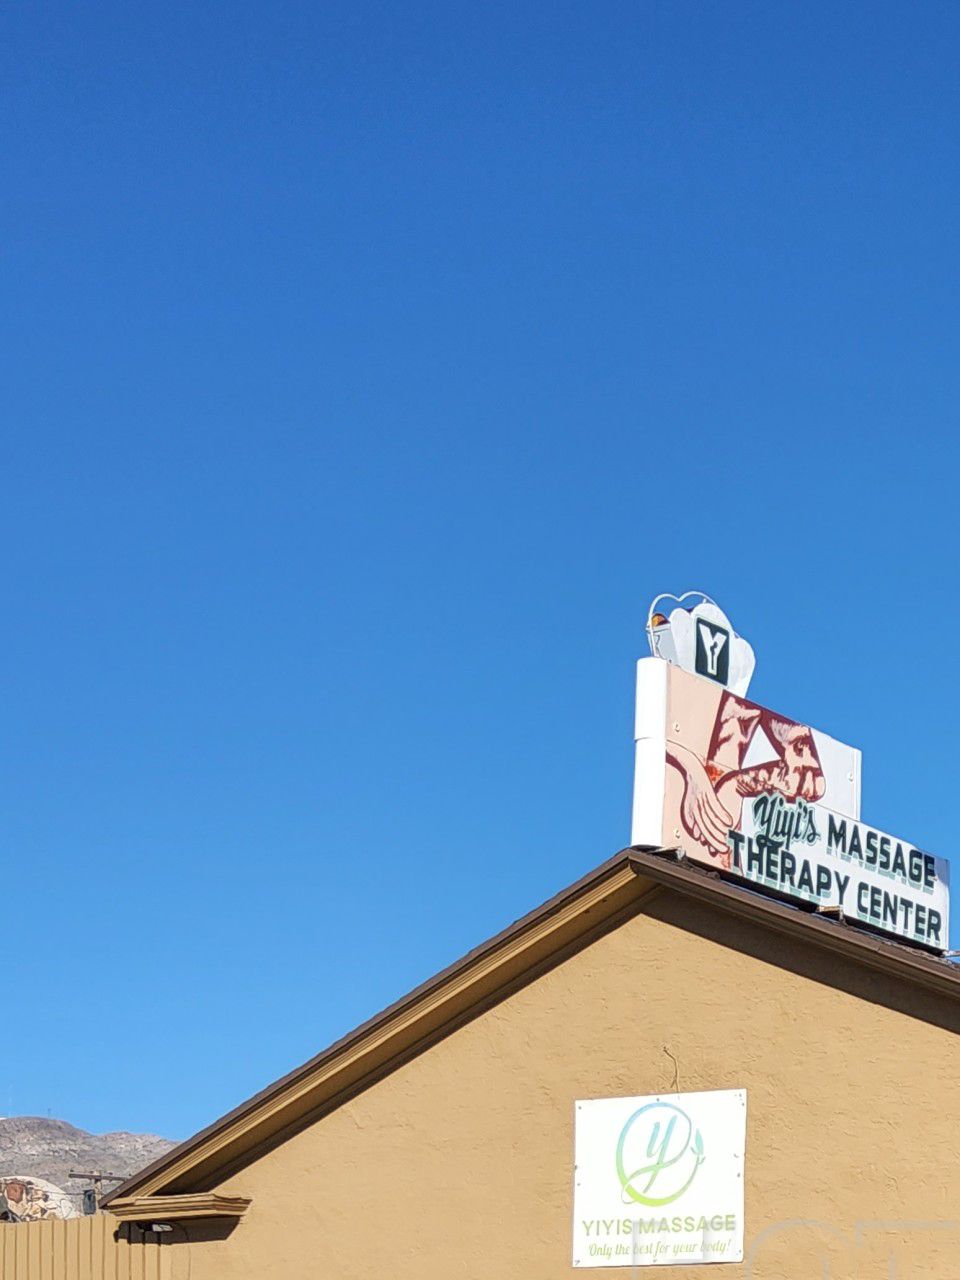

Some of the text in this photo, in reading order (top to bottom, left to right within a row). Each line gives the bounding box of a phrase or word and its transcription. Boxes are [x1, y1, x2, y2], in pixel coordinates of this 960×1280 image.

[699, 623, 727, 676] Y
[753, 795, 936, 892] Yiyi's MASSAGE
[728, 830, 942, 943] THERAPY CENTER
[582, 1214, 736, 1236] YIYIS MASSAGE
[588, 1242, 612, 1260] Only
[615, 1242, 630, 1256] the
[633, 1241, 653, 1254] best
[653, 1240, 670, 1259] for
[673, 1243, 698, 1256] your
